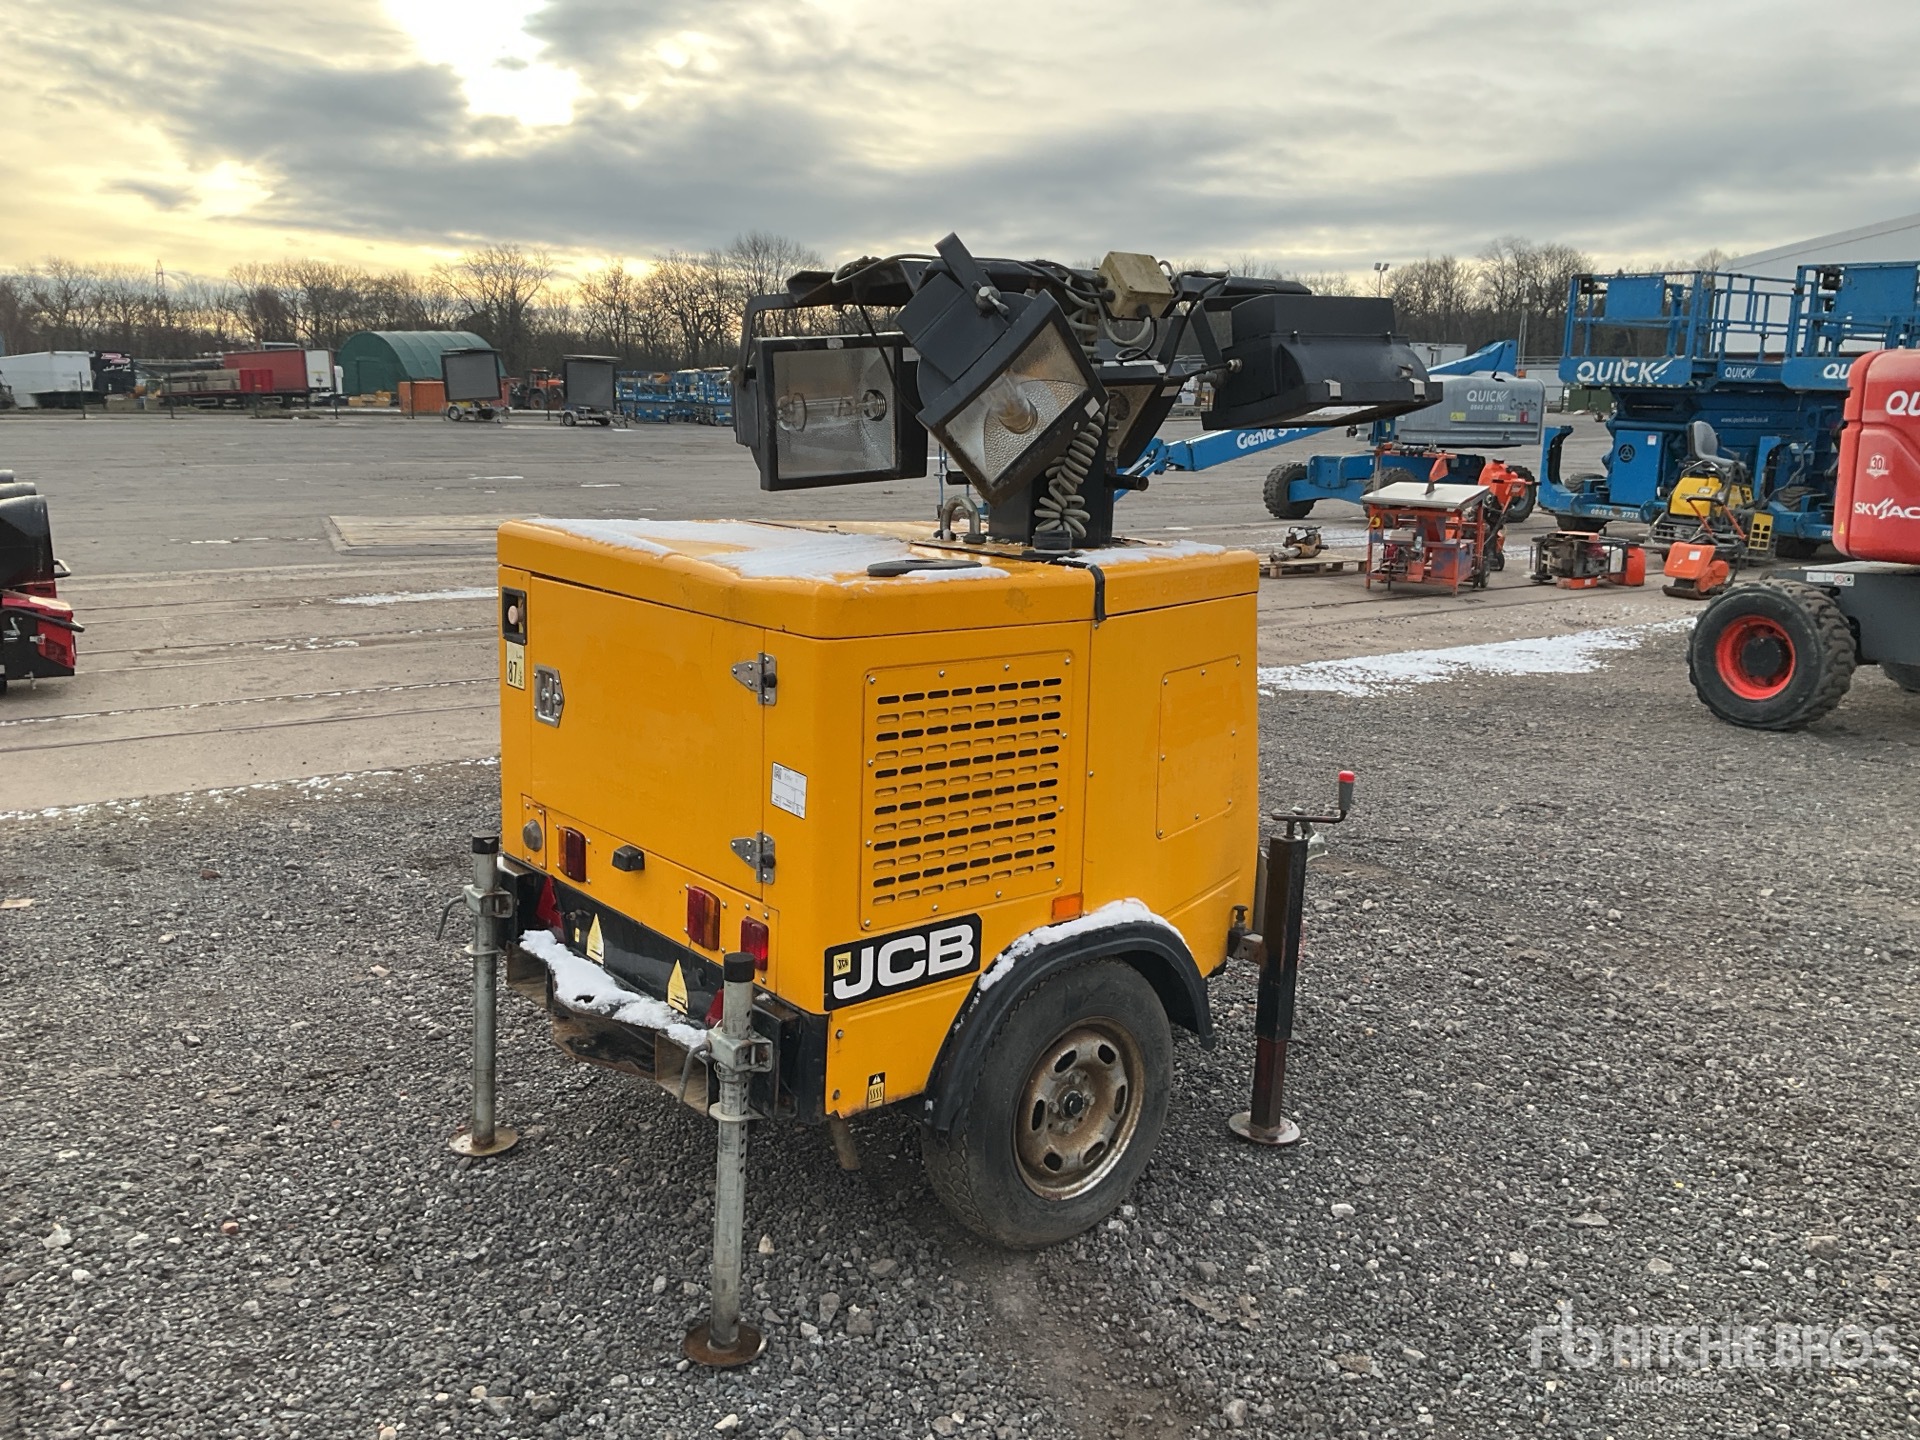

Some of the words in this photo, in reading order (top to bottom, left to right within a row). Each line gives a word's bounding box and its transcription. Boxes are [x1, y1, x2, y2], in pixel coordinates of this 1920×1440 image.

[1576, 360, 1658, 384] QUICK
[1725, 366, 1752, 379] QUICK
[1466, 389, 1504, 403] QUICK
[1236, 428, 1277, 450] Genie
[1872, 457, 1884, 470] 30
[832, 924, 974, 1000] JCB
